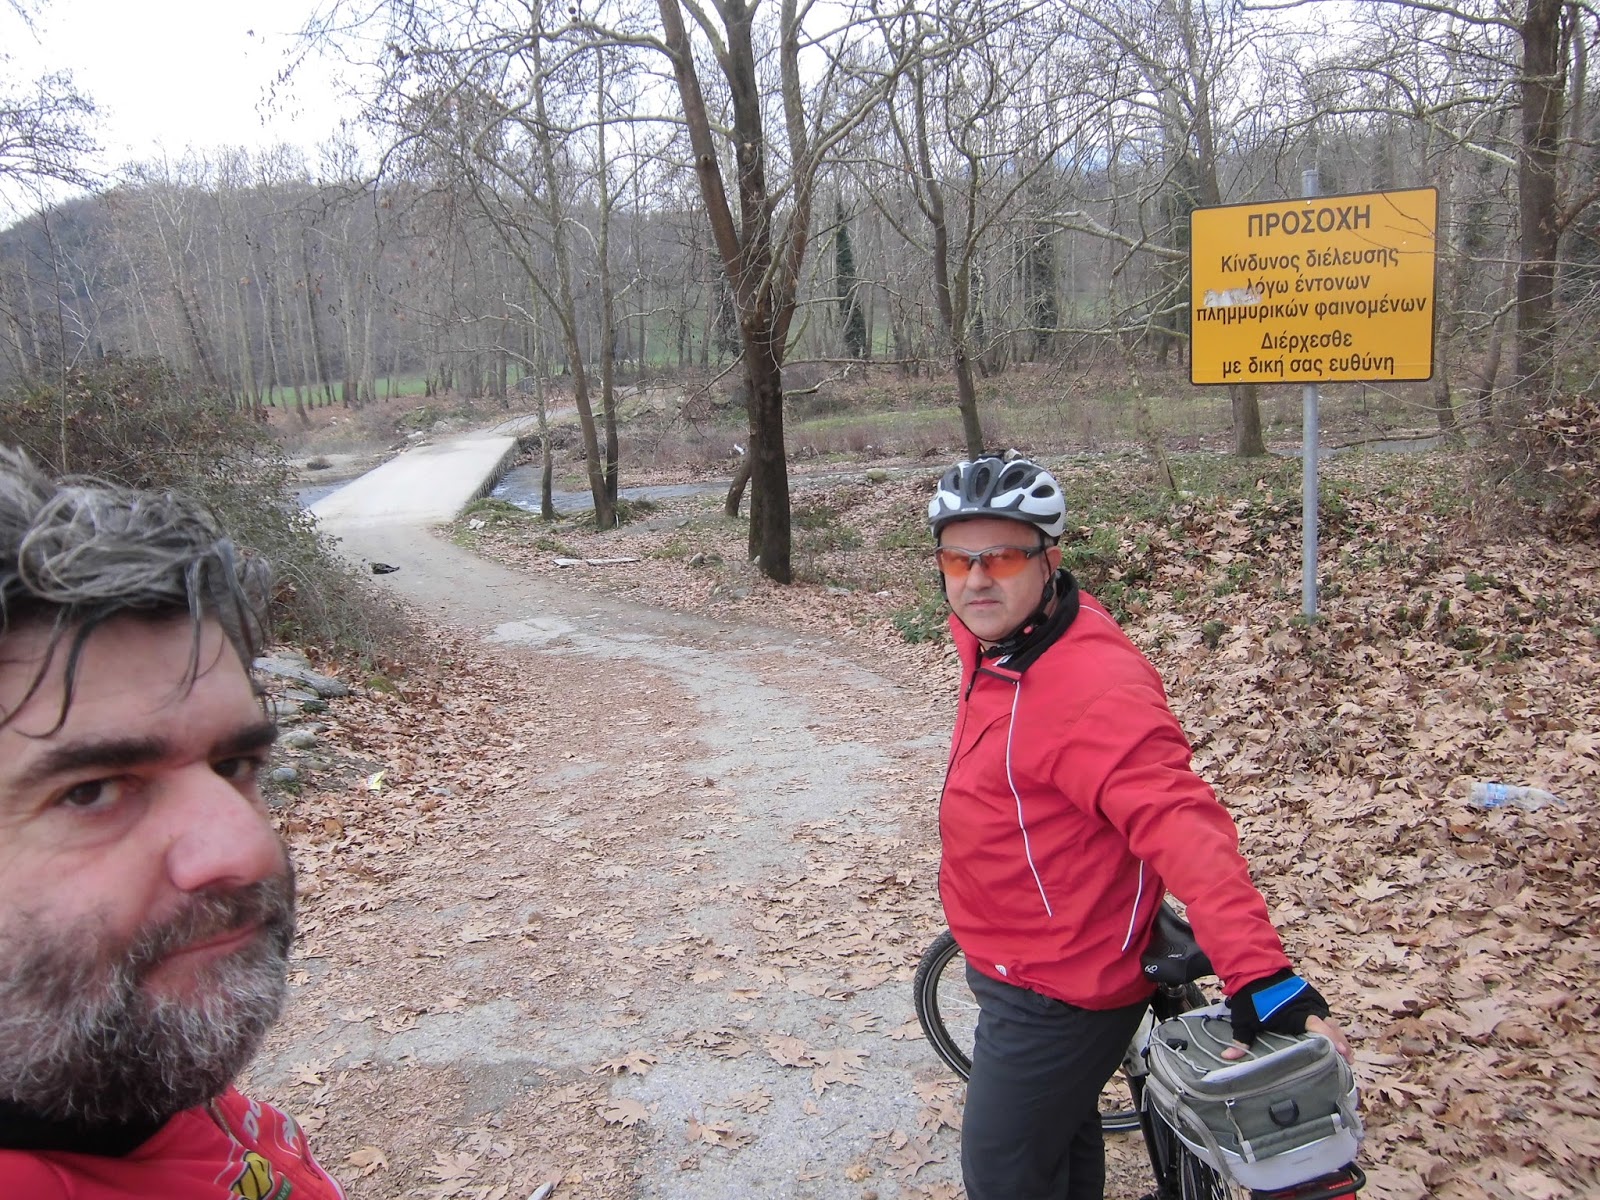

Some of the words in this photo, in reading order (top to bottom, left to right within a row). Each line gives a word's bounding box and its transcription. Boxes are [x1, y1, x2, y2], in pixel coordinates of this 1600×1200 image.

[1248, 204, 1371, 238] ΠΡΟΣΟΧΗ
[1221, 254, 1300, 273] Κίνδυνος
[1306, 247, 1399, 267] διέλευσης
[1245, 276, 1290, 299] λόγω
[1295, 274, 1370, 293] έντονων
[1197, 299, 1309, 325] πλημμυρικών
[1315, 294, 1427, 320] φαινομένων
[1261, 329, 1353, 353] Διέρχεσθε
[1223, 360, 1242, 378] με
[1249, 354, 1285, 376] δική
[1290, 359, 1323, 376] σας
[1329, 352, 1395, 375] ευθύνη
